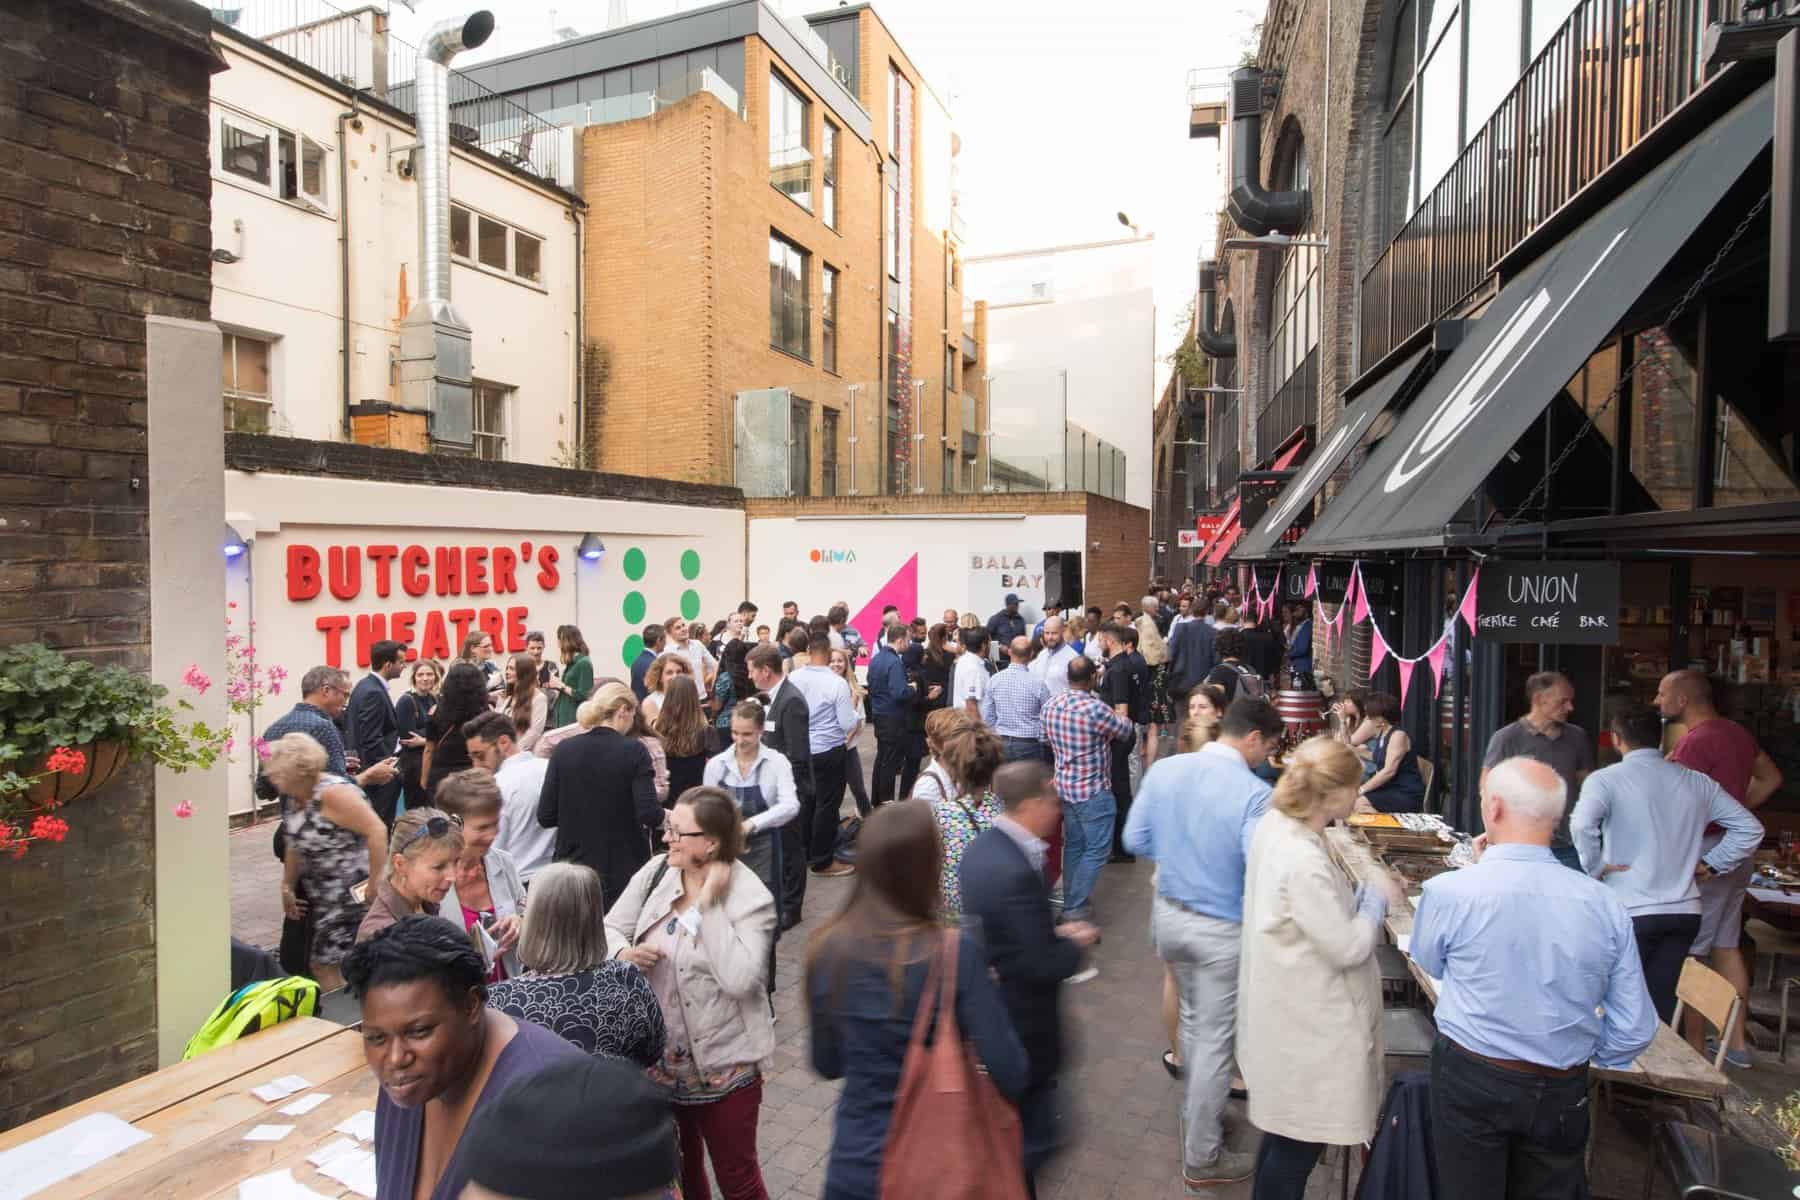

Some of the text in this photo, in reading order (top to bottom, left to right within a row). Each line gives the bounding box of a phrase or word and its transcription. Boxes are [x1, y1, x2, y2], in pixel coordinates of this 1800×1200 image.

[286, 541, 561, 602] BUTCHER'S
[972, 555, 1027, 569] BALA
[1507, 572, 1579, 604] UNION
[1530, 610, 1561, 628] CAFÉ
[1578, 615, 1609, 628] BAR
[315, 606, 529, 670] THEATRE
